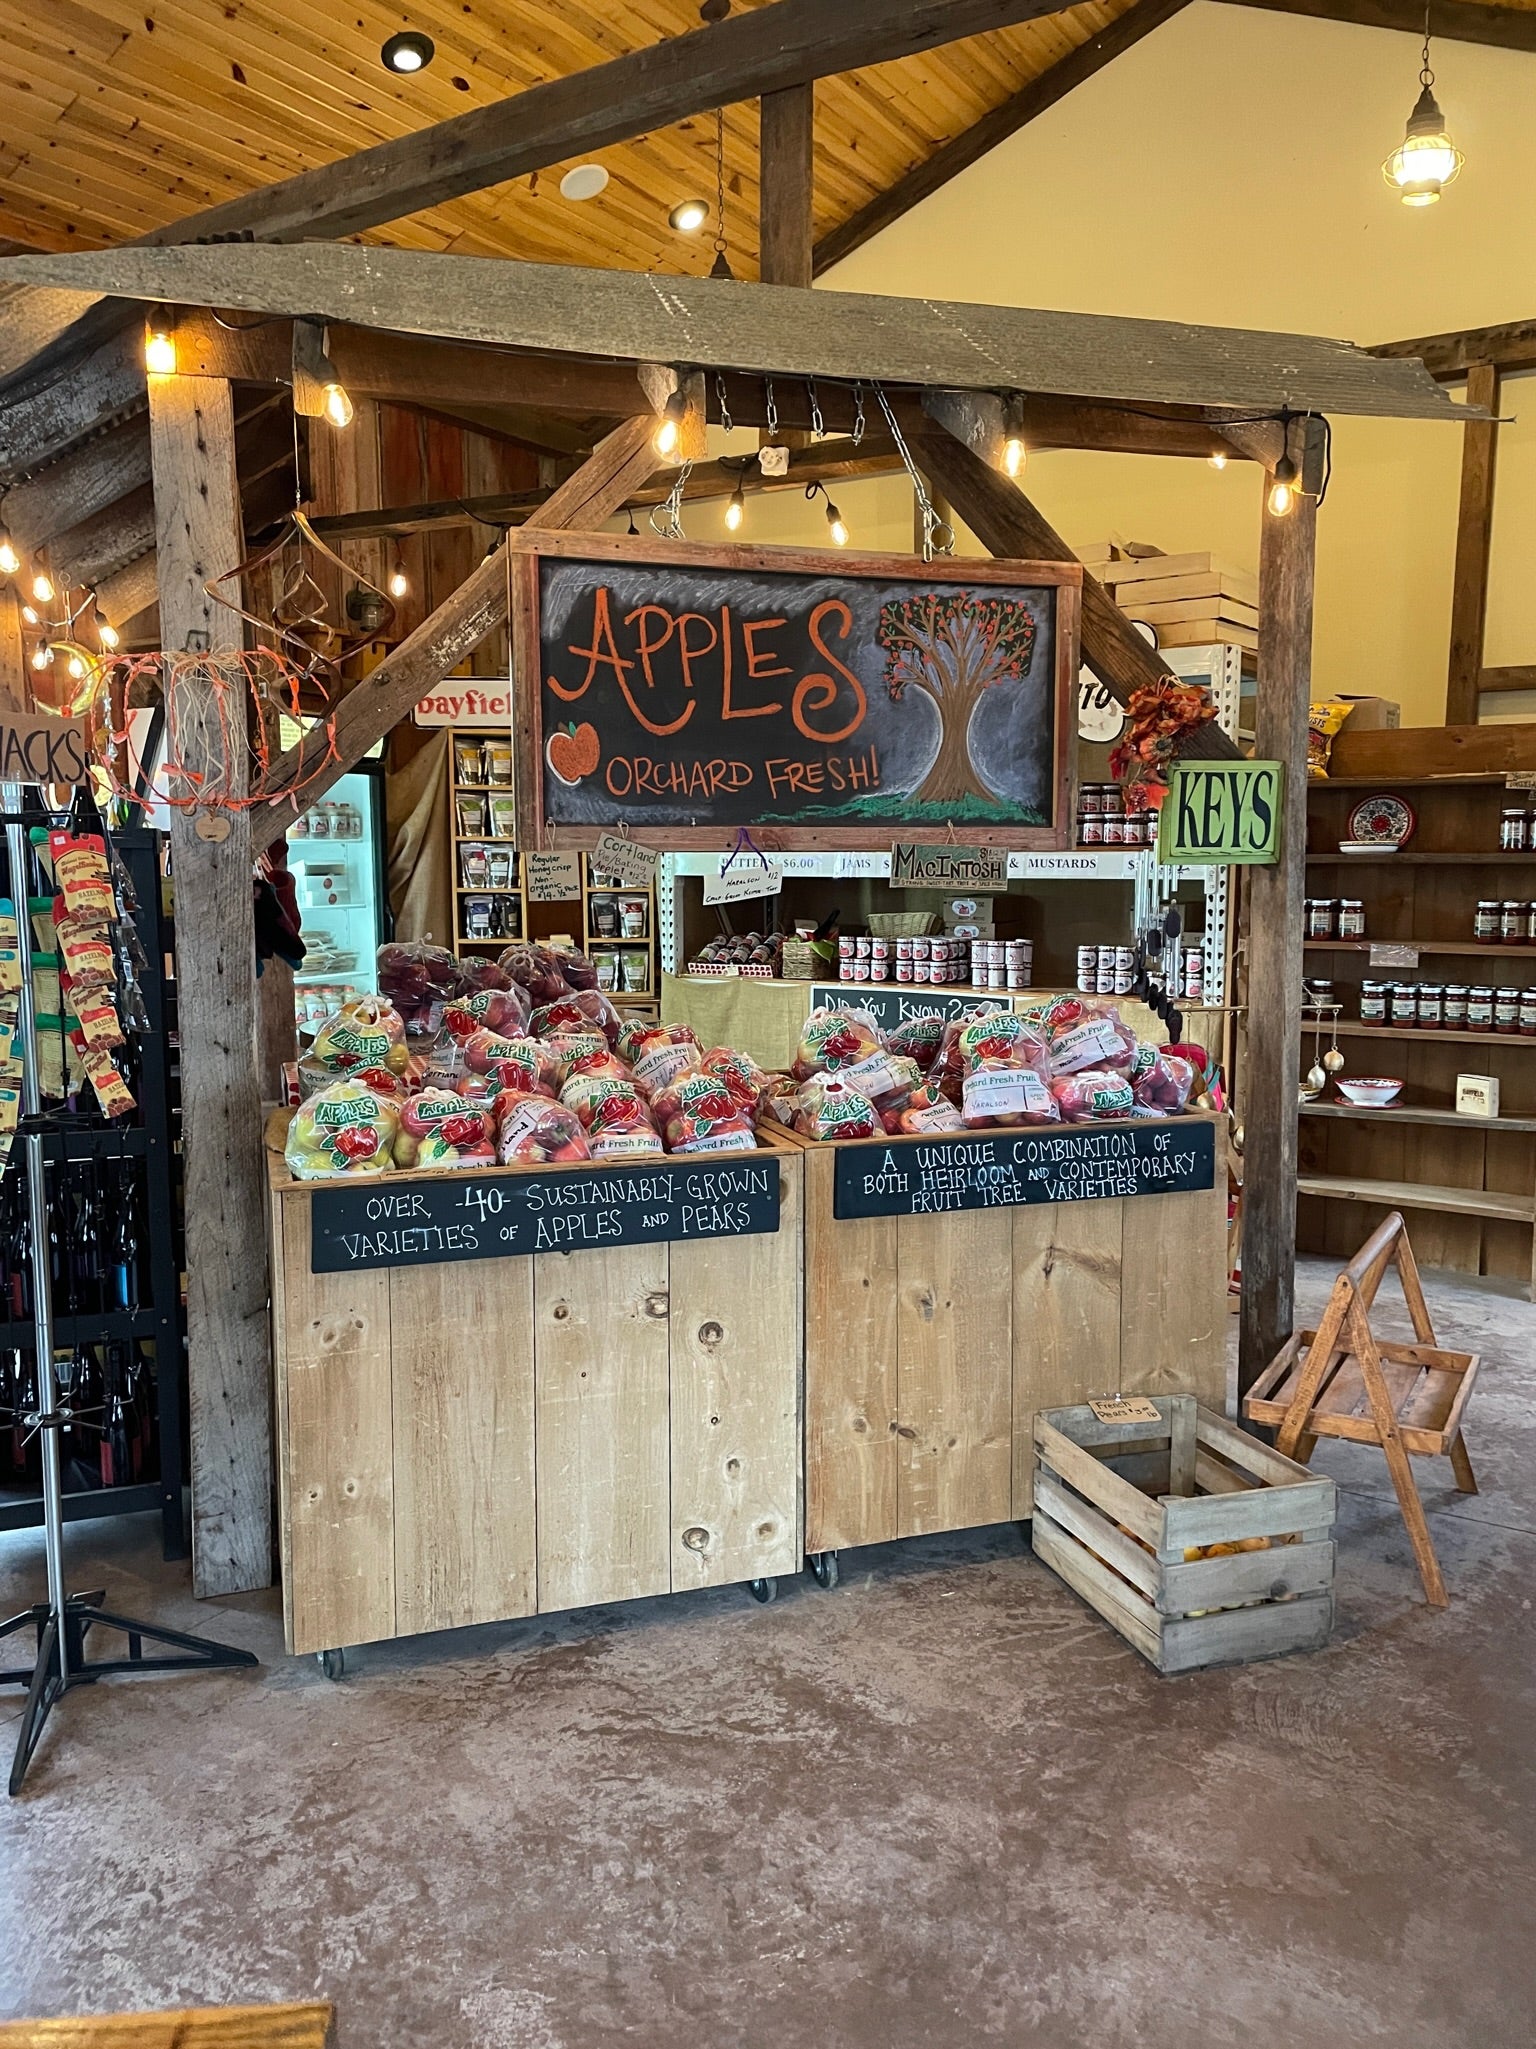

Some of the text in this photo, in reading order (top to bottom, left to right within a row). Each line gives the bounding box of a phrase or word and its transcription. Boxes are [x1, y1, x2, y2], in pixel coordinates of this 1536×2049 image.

[547, 587, 867, 743] APPLES
[0, 726, 85, 783] ACKS
[606, 745, 880, 799] ORCHARD FRESH!
[1174, 770, 1274, 850] KEYS
[531, 854, 560, 866] Regular
[603, 837, 658, 864] Cortland
[783, 858, 814, 868] $6.00
[842, 858, 871, 870] JAMS
[1008, 858, 1097, 869] & MUSTARDS
[860, 997, 886, 1017] YOU
[898, 997, 963, 1022] KNOW?
[329, 1031, 390, 1054] APPLES
[1065, 1031, 1087, 1045] Fresh
[989, 1075, 1014, 1085] Fresh
[317, 1097, 379, 1123] APPLES
[608, 1138, 635, 1149] Fresh
[720, 1135, 744, 1147] Fresh
[881, 1133, 1173, 1174] A UNIQUE COMBINATION OF
[862, 1151, 1196, 1196] BOTH HEIRLOOM AND CONTEMPORARY
[365, 1194, 432, 1222] OVER
[911, 1178, 1139, 1214] FRUIT TREE VARIETIES
[340, 1202, 752, 1261] VARIETIES OF APPLES AND PEARS
[1095, 1400, 1132, 1410] French
